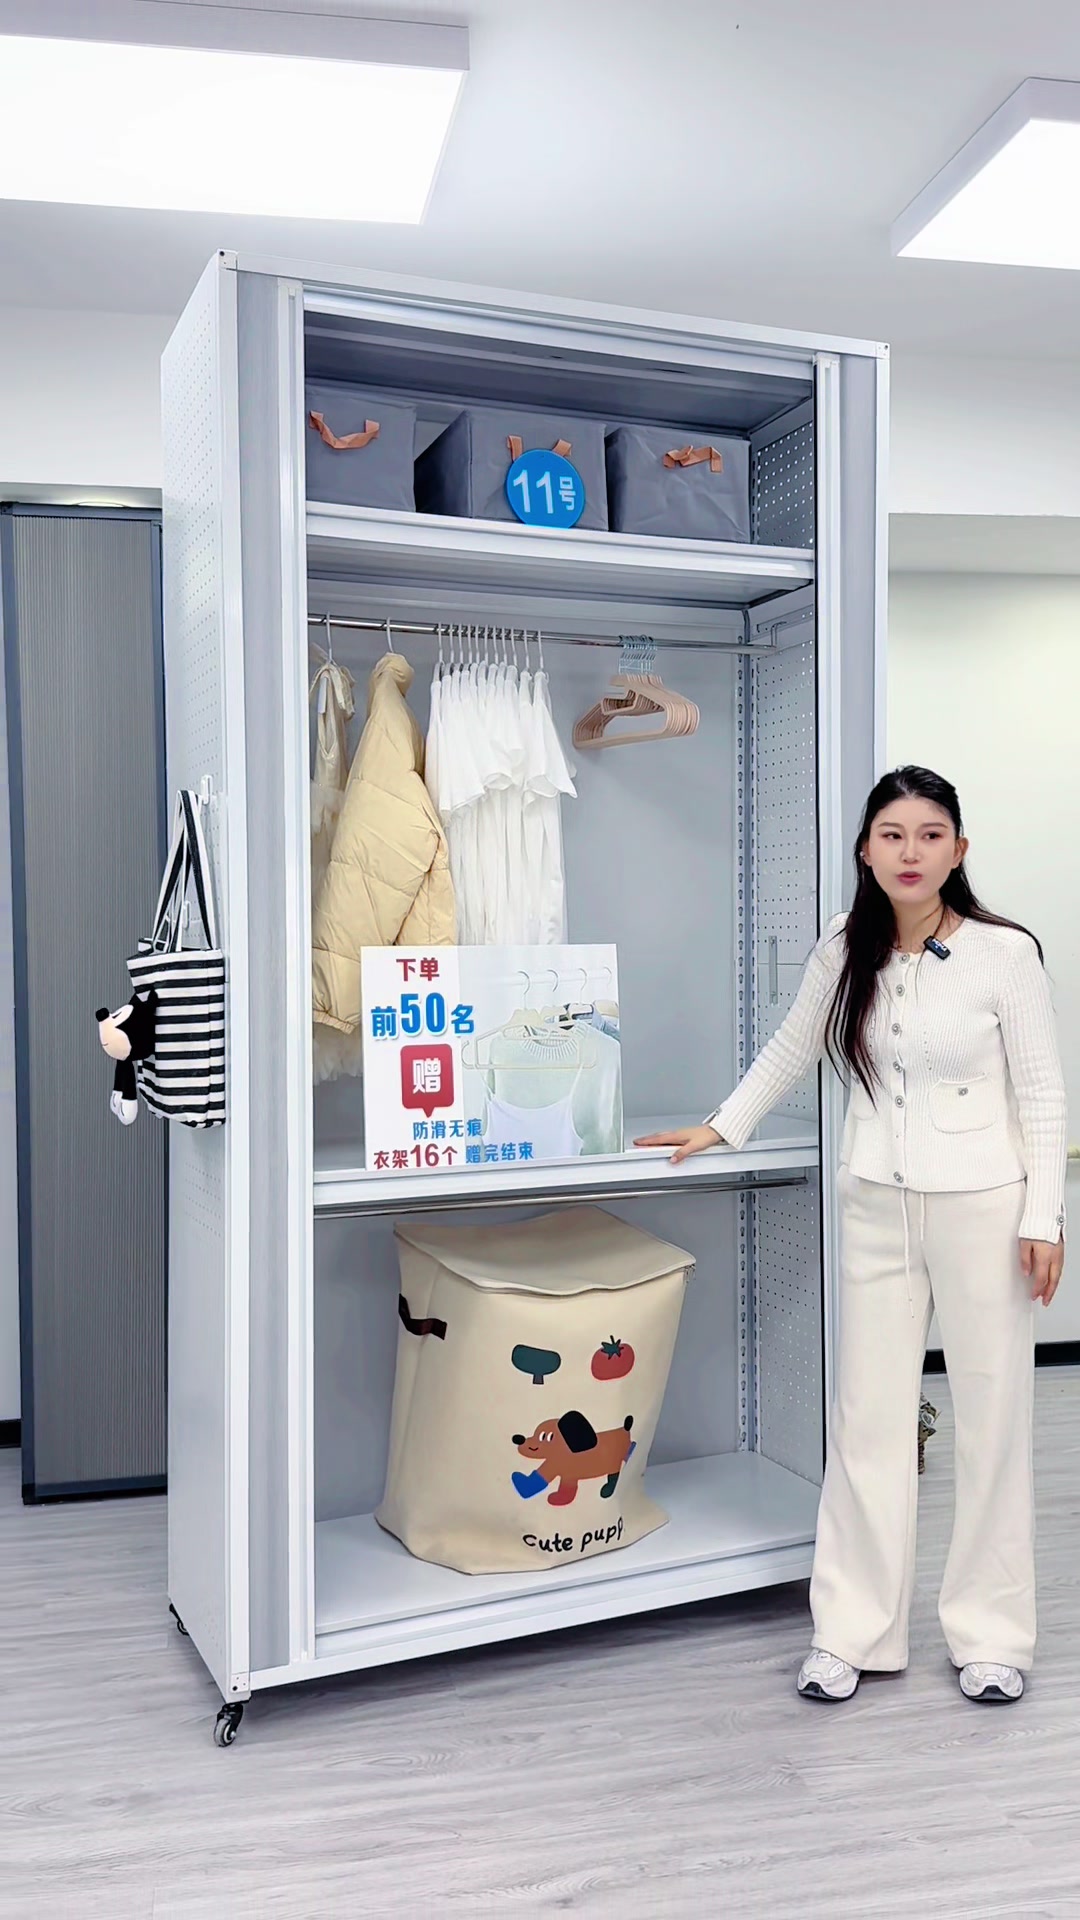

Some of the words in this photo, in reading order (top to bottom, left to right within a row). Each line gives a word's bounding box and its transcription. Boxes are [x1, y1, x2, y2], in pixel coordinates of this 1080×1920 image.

[513, 469, 576, 514] 11号
[396, 957, 440, 982] 下单
[371, 992, 475, 1038] 前50名
[412, 1057, 442, 1095] 赠
[413, 1118, 483, 1140] 防滑无痕
[373, 1143, 458, 1169] 衣架16个
[465, 1141, 534, 1164] 赠完结束
